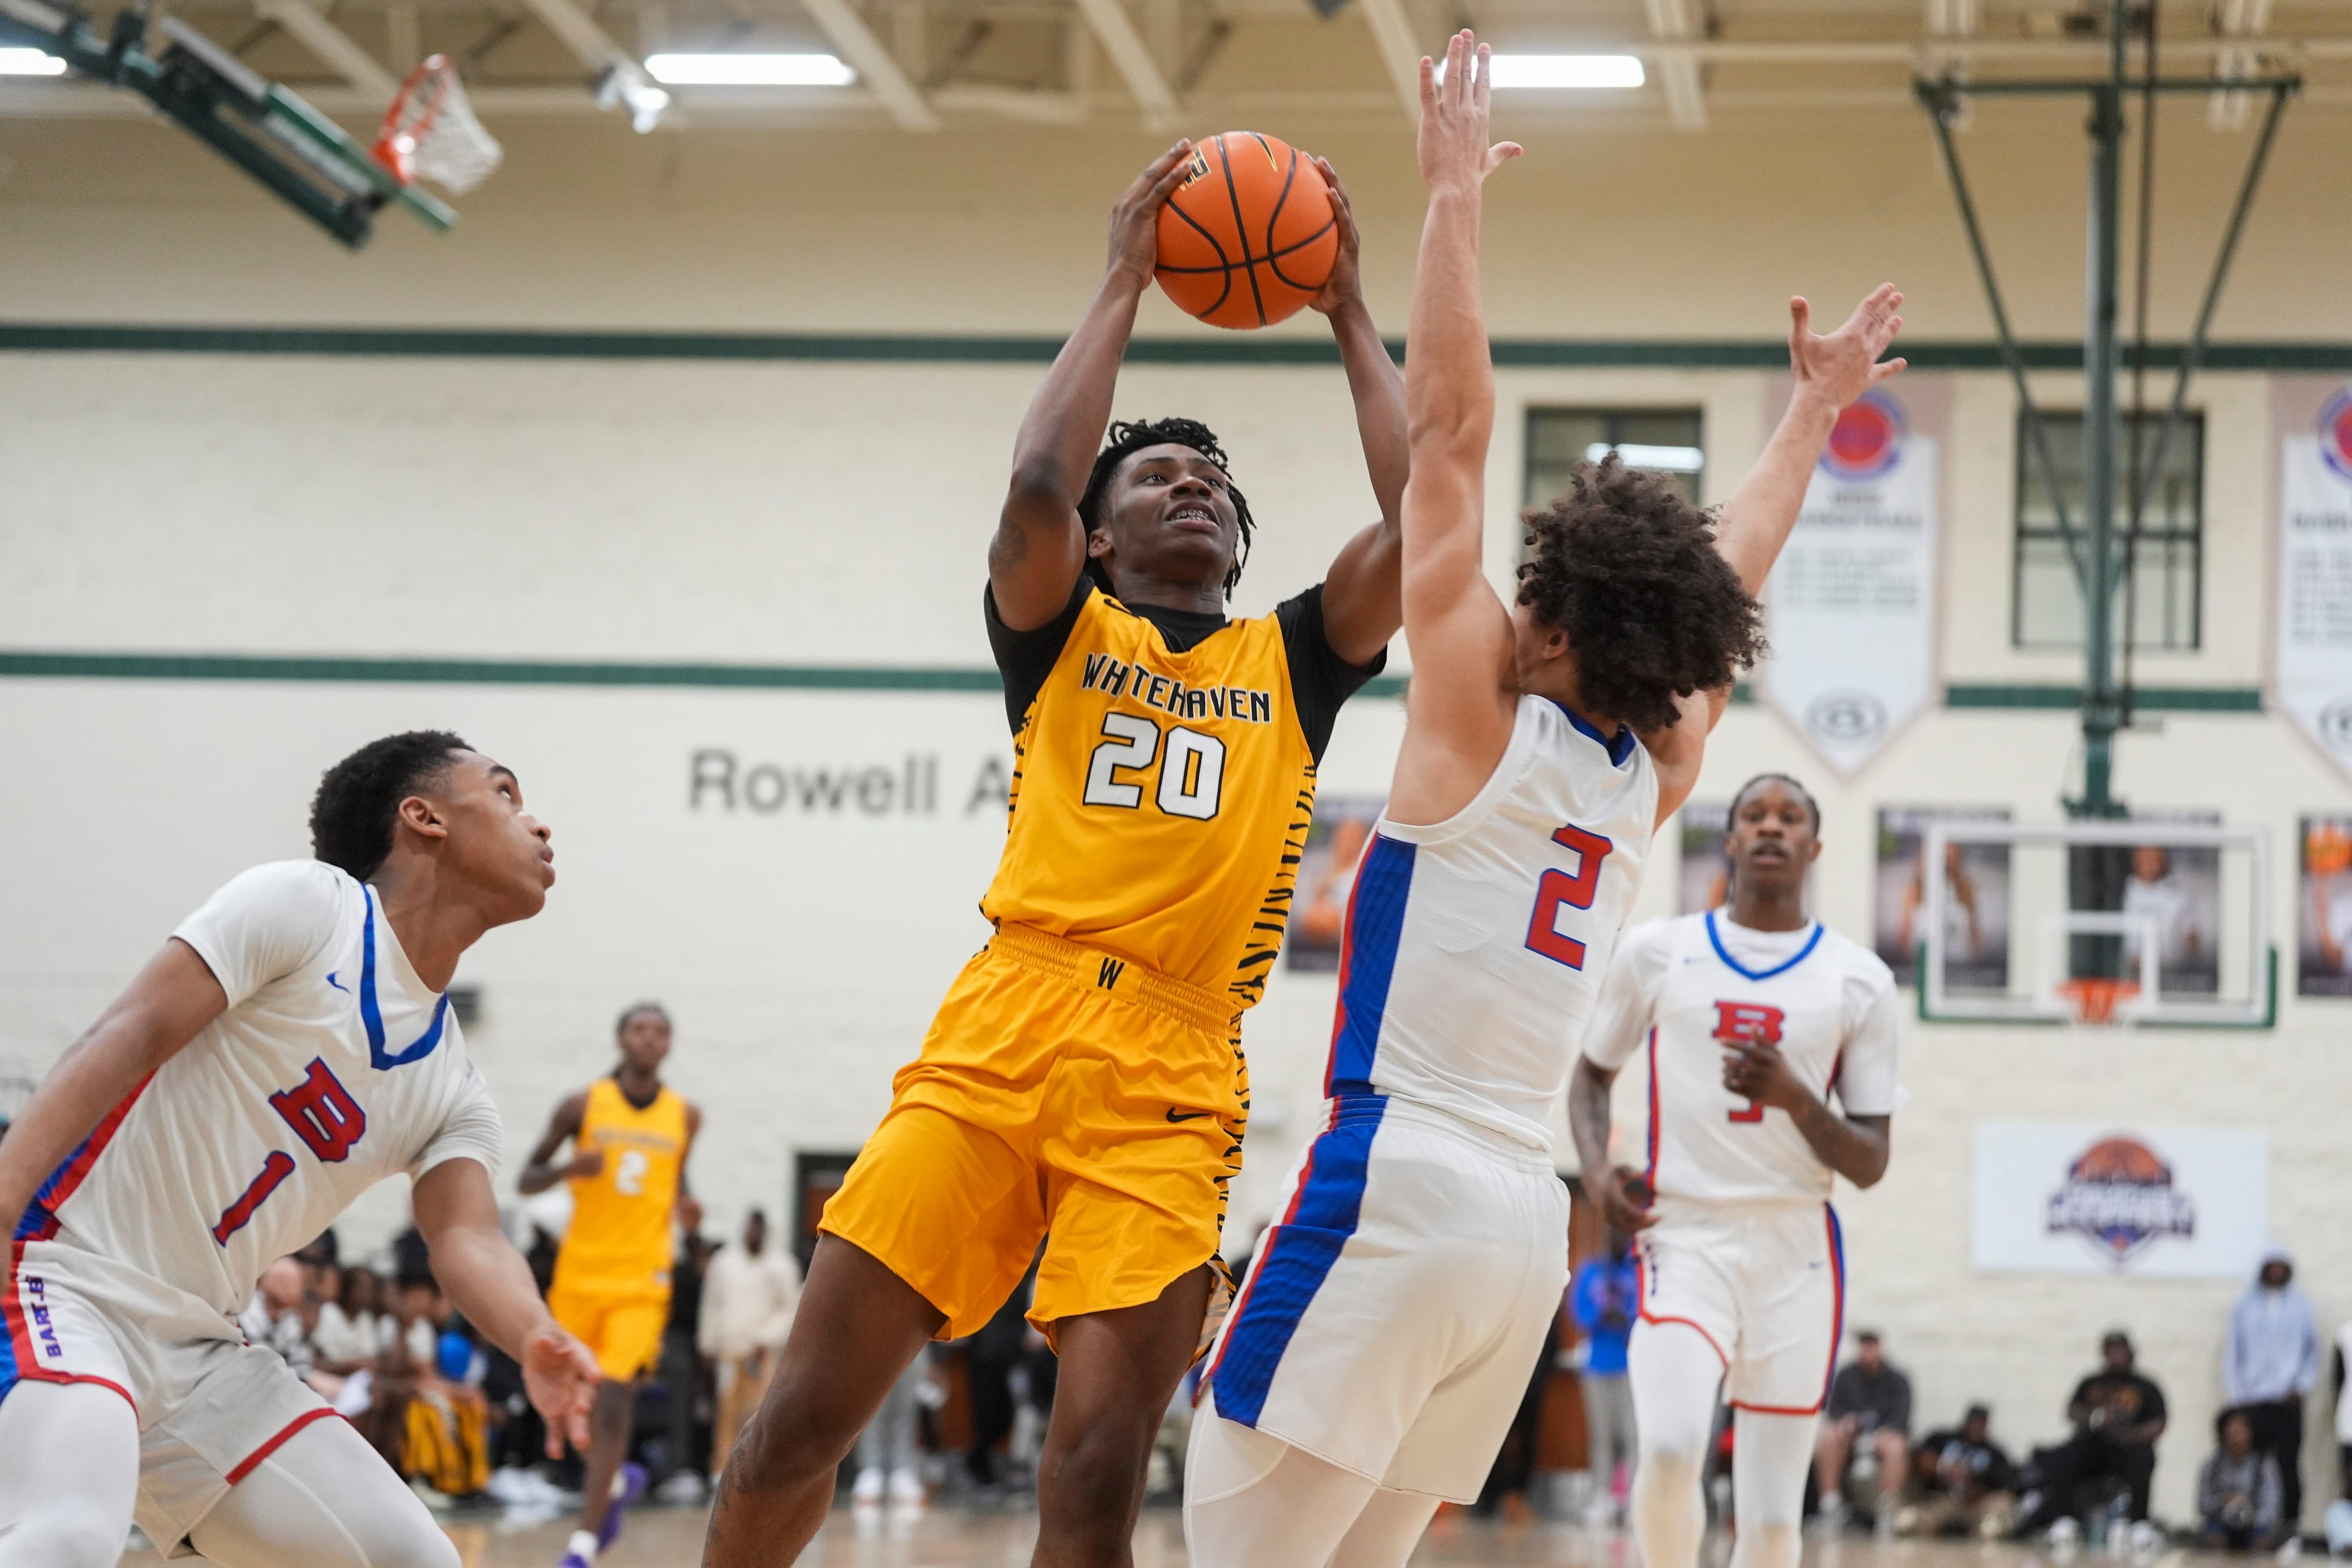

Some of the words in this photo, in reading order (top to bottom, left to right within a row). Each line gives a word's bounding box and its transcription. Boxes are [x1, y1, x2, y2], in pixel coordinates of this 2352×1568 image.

[1081, 652, 1272, 724] WHTEHAVEN
[690, 748, 939, 815] Rowell
[1083, 711, 1227, 821] 20
[1524, 823, 1613, 972] 2
[1097, 957, 1125, 991] W
[268, 1055, 366, 1163] B
[212, 1150, 295, 1248] 1
[616, 1151, 647, 1196] 2
